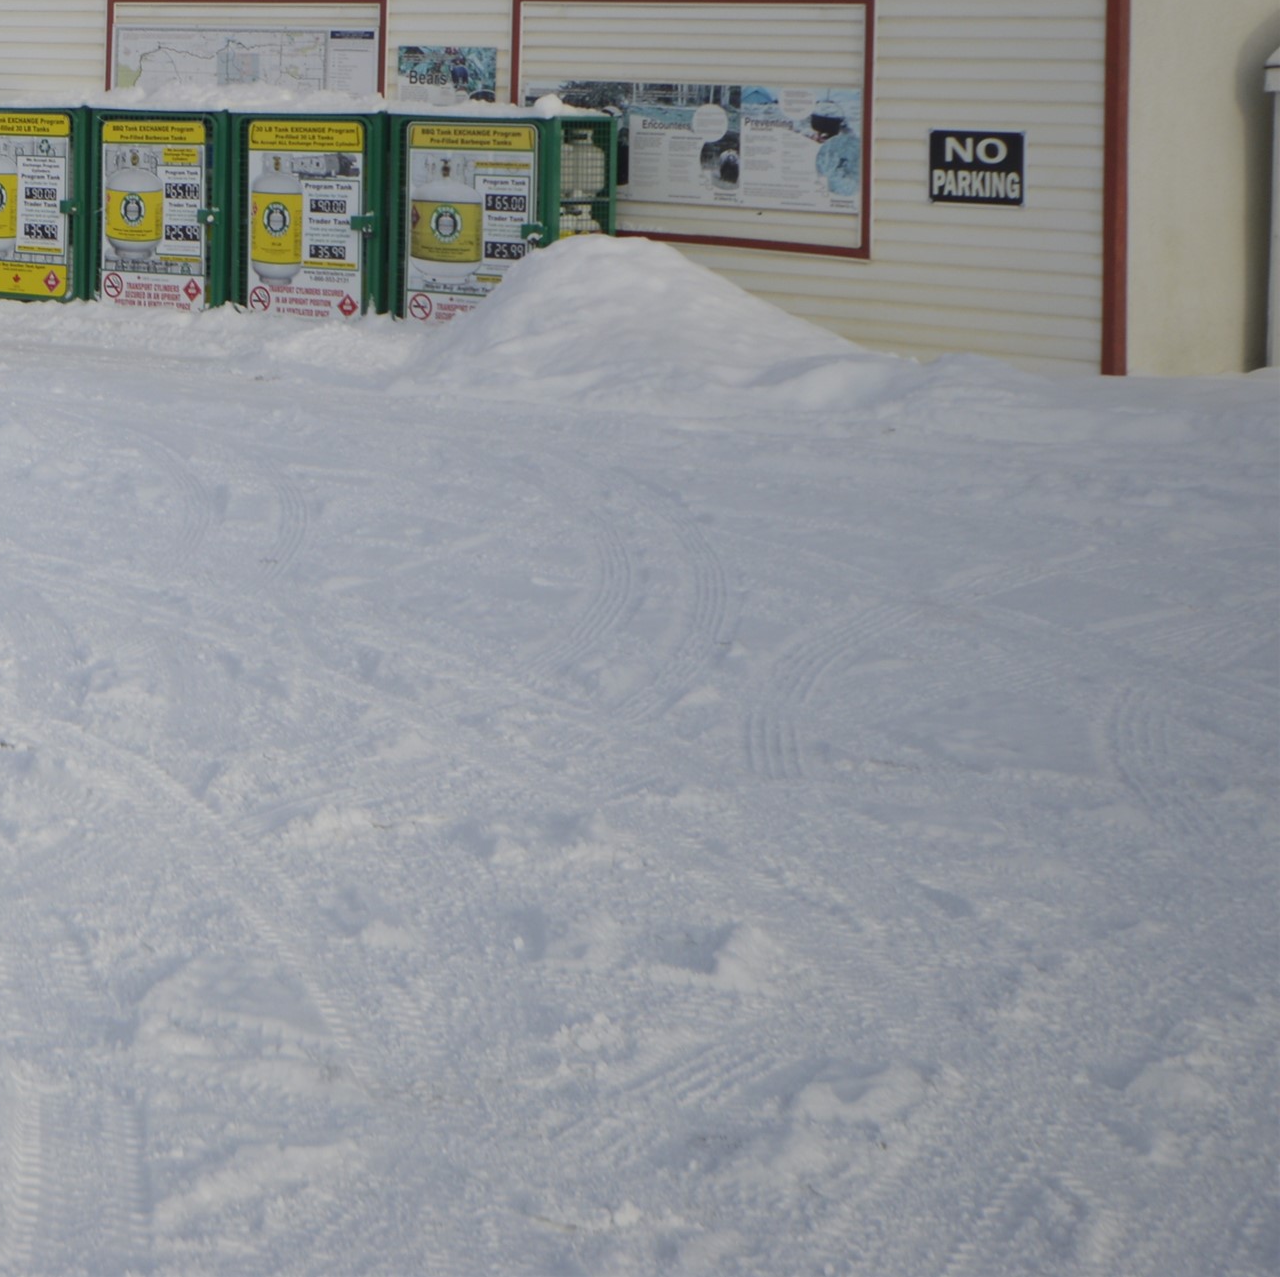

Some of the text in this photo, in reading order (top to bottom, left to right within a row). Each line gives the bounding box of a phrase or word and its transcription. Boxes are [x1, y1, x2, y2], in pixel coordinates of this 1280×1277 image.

[409, 70, 447, 85] Bears
[642, 119, 691, 131] Encounters
[744, 117, 793, 129] Preventing
[493, 130, 522, 138] Program
[944, 136, 1008, 165] NO
[305, 183, 334, 191] Program
[932, 169, 1020, 200] PARKING
[126, 282, 180, 292] TRANSPORT CYLINDERS
[269, 285, 295, 294] TRANSPORT
[296, 287, 321, 295] CYLINDERS
[125, 291, 145, 299] SECURED
[161, 293, 181, 301] UPRIGHT
[288, 297, 308, 305] UPRIGHT
